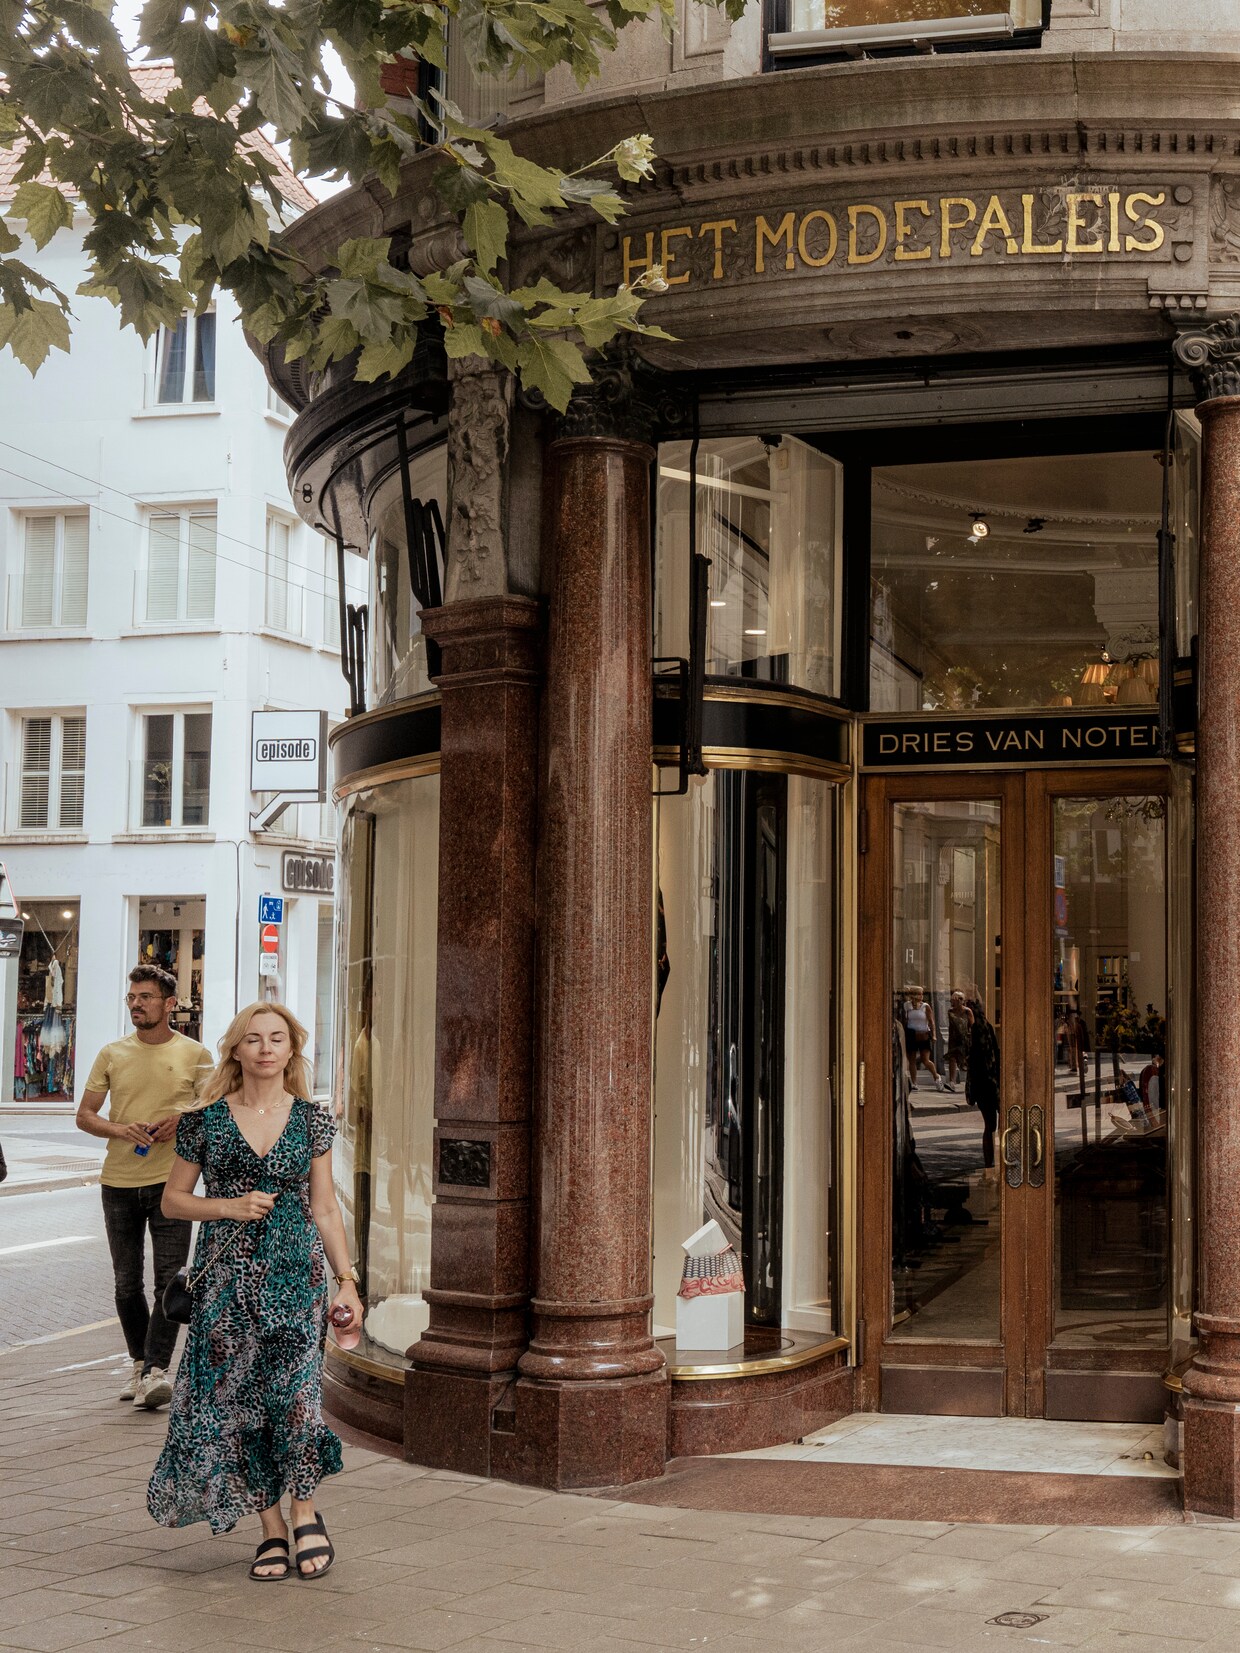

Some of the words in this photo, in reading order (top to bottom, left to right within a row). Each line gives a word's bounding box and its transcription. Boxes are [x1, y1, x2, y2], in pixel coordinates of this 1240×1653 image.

[622, 218, 738, 288] HET
[755, 191, 1166, 273] MODEPALEIS
[261, 740, 310, 760] episode
[879, 731, 974, 754] DRIES
[985, 729, 1044, 750] VAN
[286, 855, 334, 890] episode
